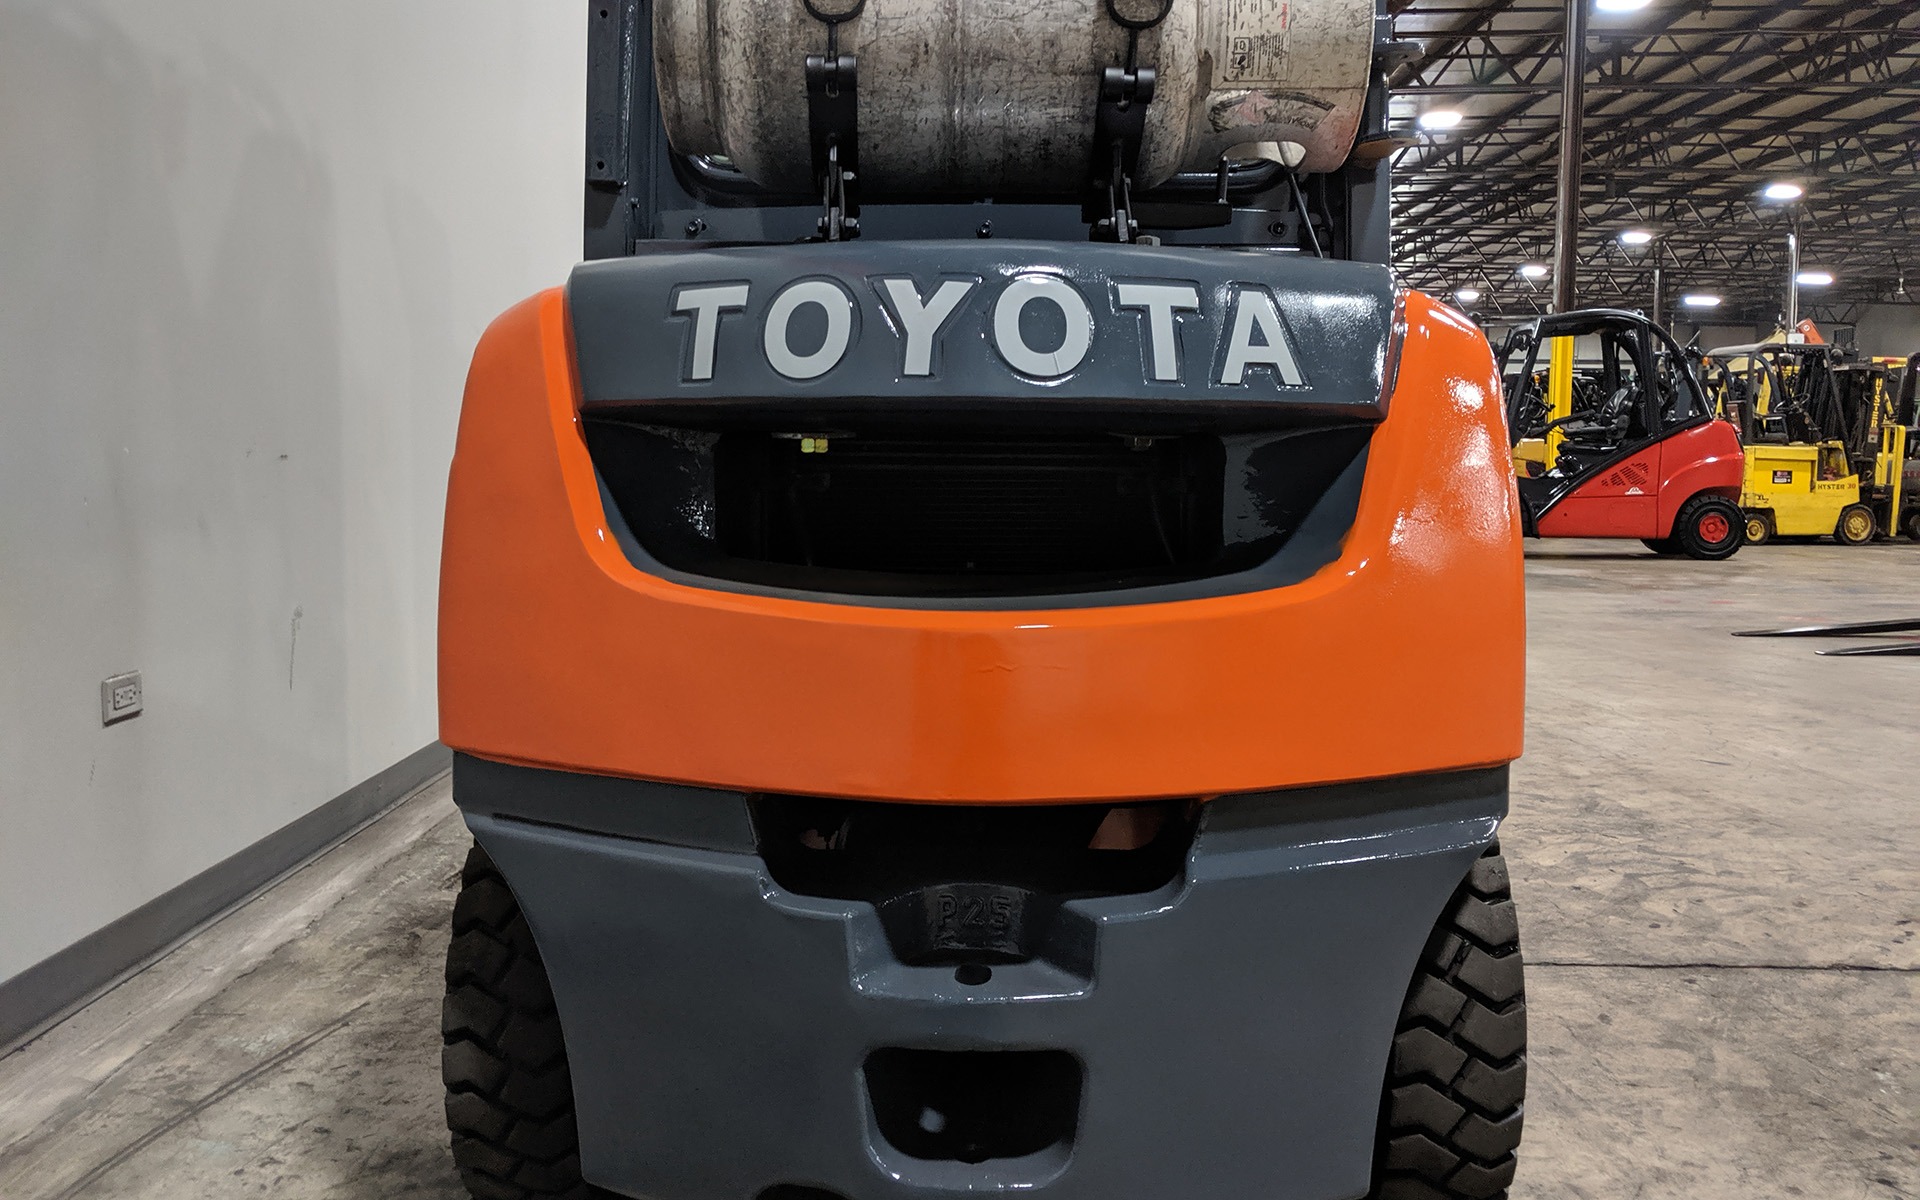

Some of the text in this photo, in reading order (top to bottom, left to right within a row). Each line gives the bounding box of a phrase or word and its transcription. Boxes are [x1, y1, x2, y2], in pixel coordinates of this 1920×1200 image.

[674, 276, 1304, 387] TOYOTA
[1870, 377, 1884, 428] HYSTER
[936, 893, 1012, 928] P25
